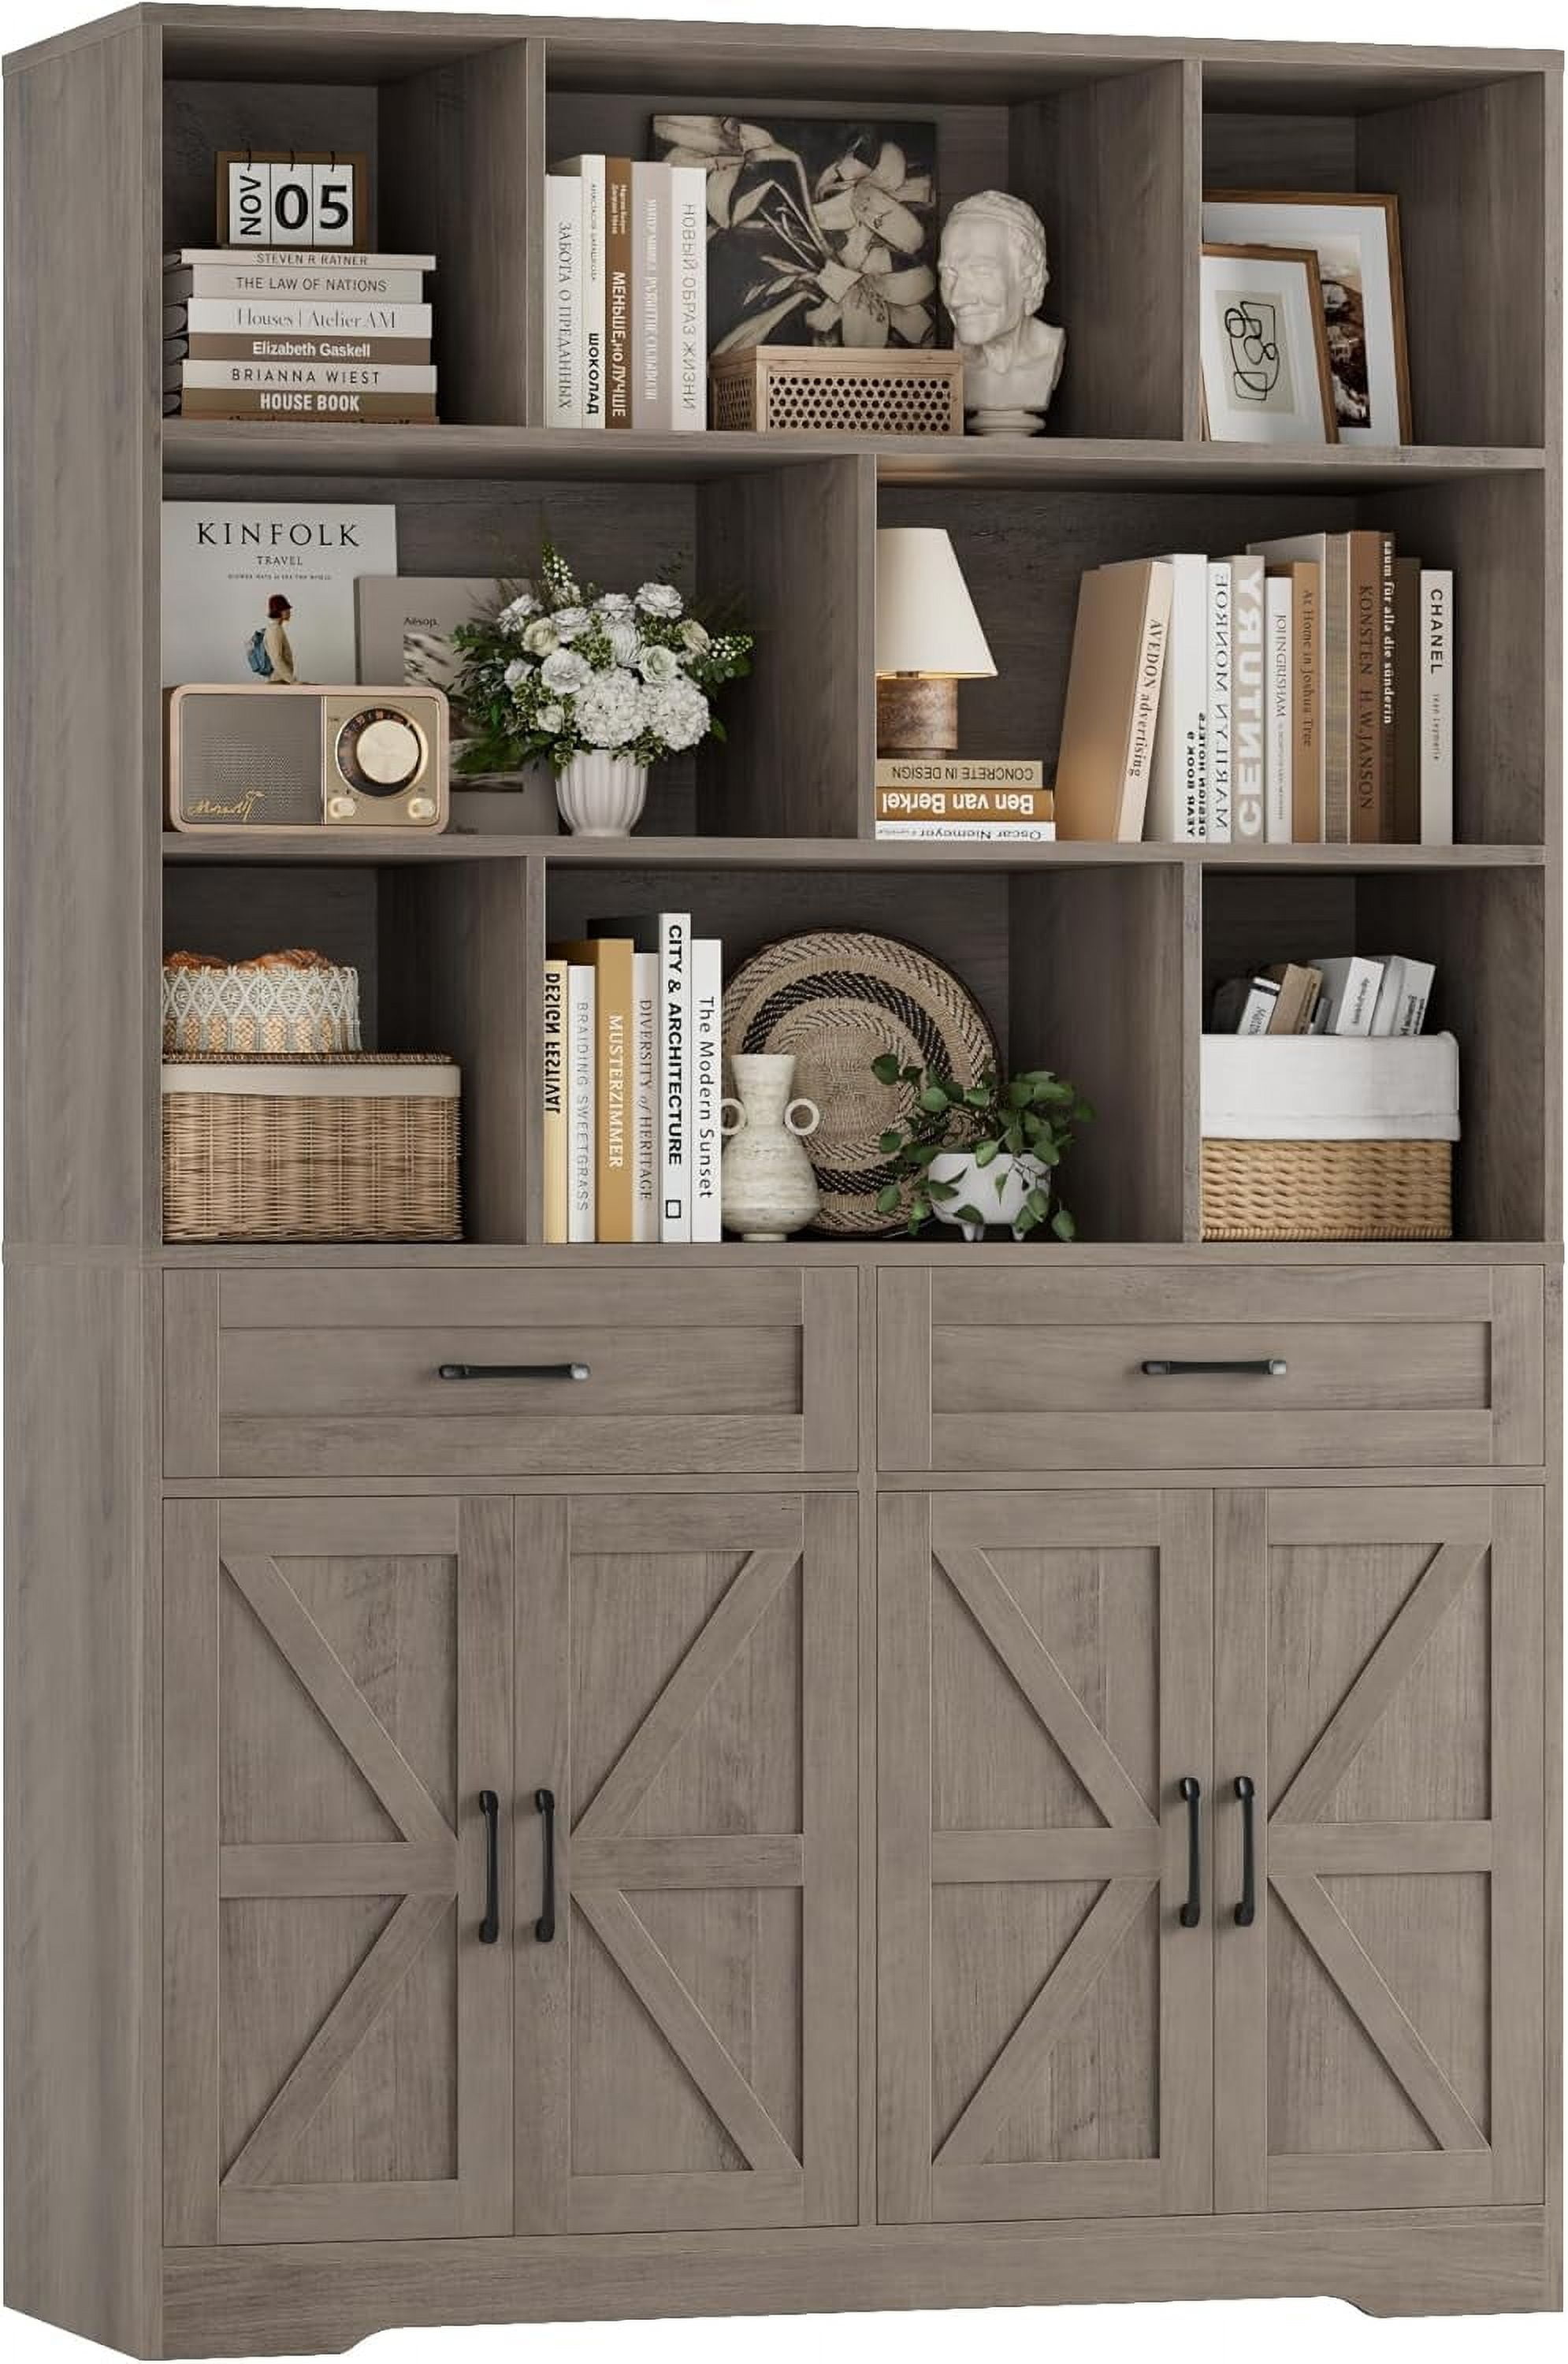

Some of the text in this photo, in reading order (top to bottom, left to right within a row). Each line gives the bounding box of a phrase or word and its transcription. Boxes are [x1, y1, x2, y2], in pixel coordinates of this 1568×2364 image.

[240, 175, 262, 236] NOV
[256, 253, 367, 266] STEVEN R RATNER
[559, 222, 572, 282] ЗАБОТА
[236, 277, 388, 292] THE LAW OF NATIONS
[238, 308, 293, 327] Houses
[313, 309, 362, 328] Atelier
[680, 203, 697, 410] НОВЫЙ ОБРАЗ ЖИЗНИ
[253, 341, 371, 358] Elizabeth Gaskell
[558, 307, 572, 408] ПРЕДАННЫХ
[232, 368, 380, 385] BRIANNA WIEST
[586, 333, 599, 414] ШОКОЛАД
[612, 363, 626, 417] ЛУЧШЕ
[260, 394, 360, 411] HOUSE BOOK
[197, 522, 359, 547] KINFOLK
[257, 556, 303, 566] TRAVEL
[1302, 611, 1313, 647] Home
[1359, 585, 1373, 675] KONSTEN
[1384, 636, 1395, 658] die
[1430, 589, 1443, 675] CHANEL
[1302, 652, 1313, 664] in
[1128, 619, 1162, 777] AVEDON advertising
[1300, 668, 1313, 713] Joshua
[1302, 719, 1313, 748] Tree
[892, 767, 1034, 780] CONCRETE IN DESIGN
[882, 792, 1034, 815] Ben van Berkel
[920, 828, 991, 839] Niemeyer
[994, 829, 1041, 840] Oscar
[667, 924, 682, 1166] CITY & ARCHITECTURE
[577, 1002, 589, 1211] BRAIDING SWEETGRASS
[608, 1014, 623, 1169] MUSTERZIMMER
[638, 1000, 652, 1200] DIVERSITY of HERITAGE
[699, 996, 715, 1198] The Modern Sunset
